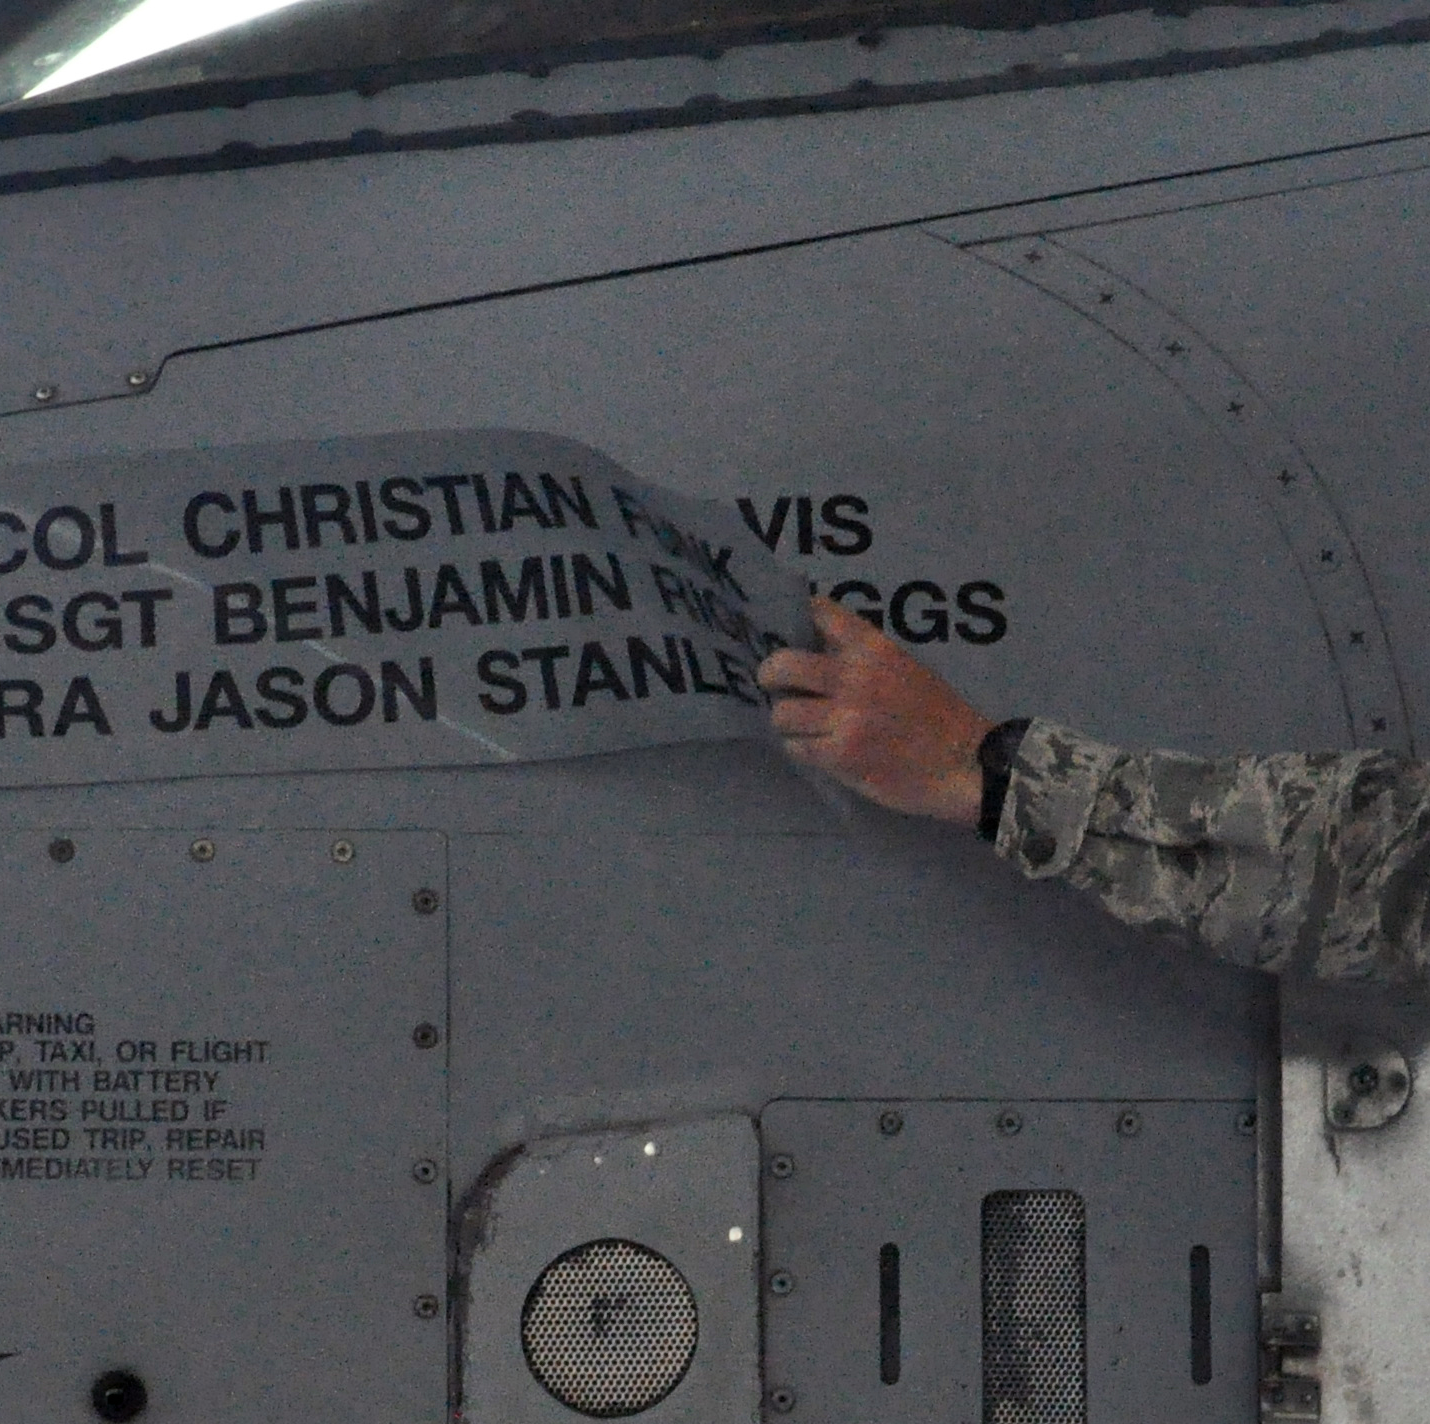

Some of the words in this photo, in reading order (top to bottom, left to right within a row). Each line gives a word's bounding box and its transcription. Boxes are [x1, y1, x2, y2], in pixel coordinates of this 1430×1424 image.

[182, 471, 600, 559] CHRISTIAN
[734, 494, 873, 556] VIS
[213, 551, 633, 646] BENJAMIN
[149, 656, 439, 733] JASON
[476, 635, 771, 716] STANLE
[115, 1039, 158, 1063] OR
[171, 1039, 270, 1063] FLIGHT
[8, 1069, 82, 1093] WITH
[93, 1069, 219, 1093] BATTERY
[82, 1098, 189, 1122] PULLED
[204, 1098, 228, 1122] IF
[167, 1127, 266, 1151] REPAIR
[167, 1156, 263, 1181] RESET
